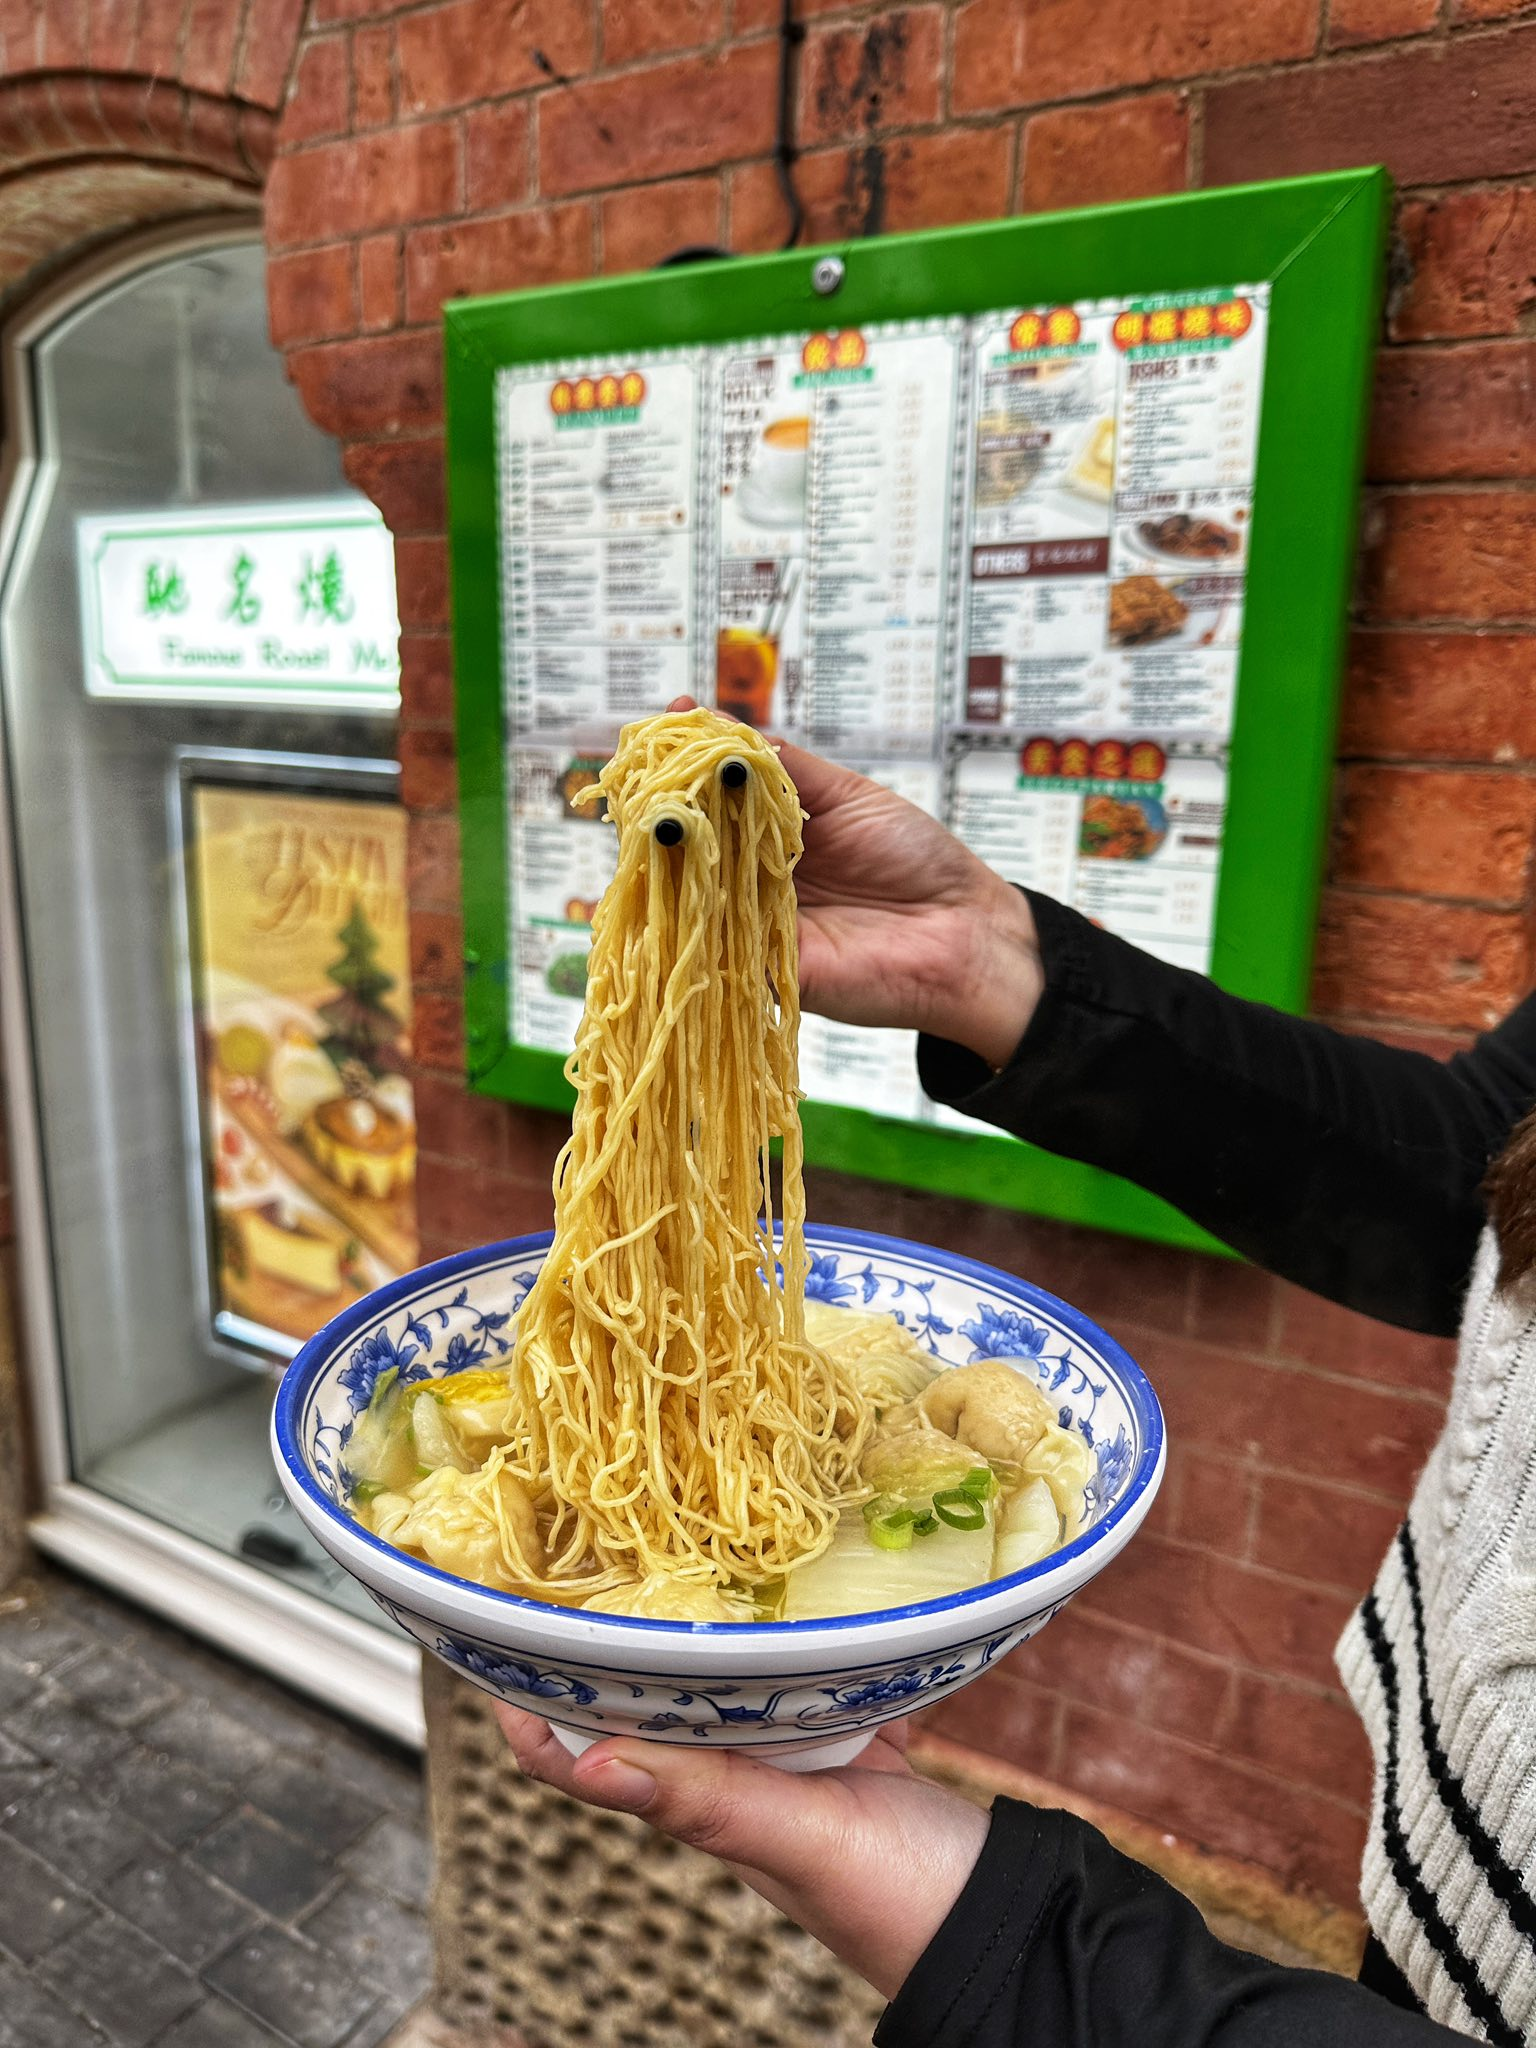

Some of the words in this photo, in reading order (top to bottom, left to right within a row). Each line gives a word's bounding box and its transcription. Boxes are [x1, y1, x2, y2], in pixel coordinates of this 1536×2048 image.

[141, 551, 355, 623] 馳名燒
[160, 636, 242, 666] Famous
[261, 637, 329, 668] Roast
[352, 640, 397, 672] Me
